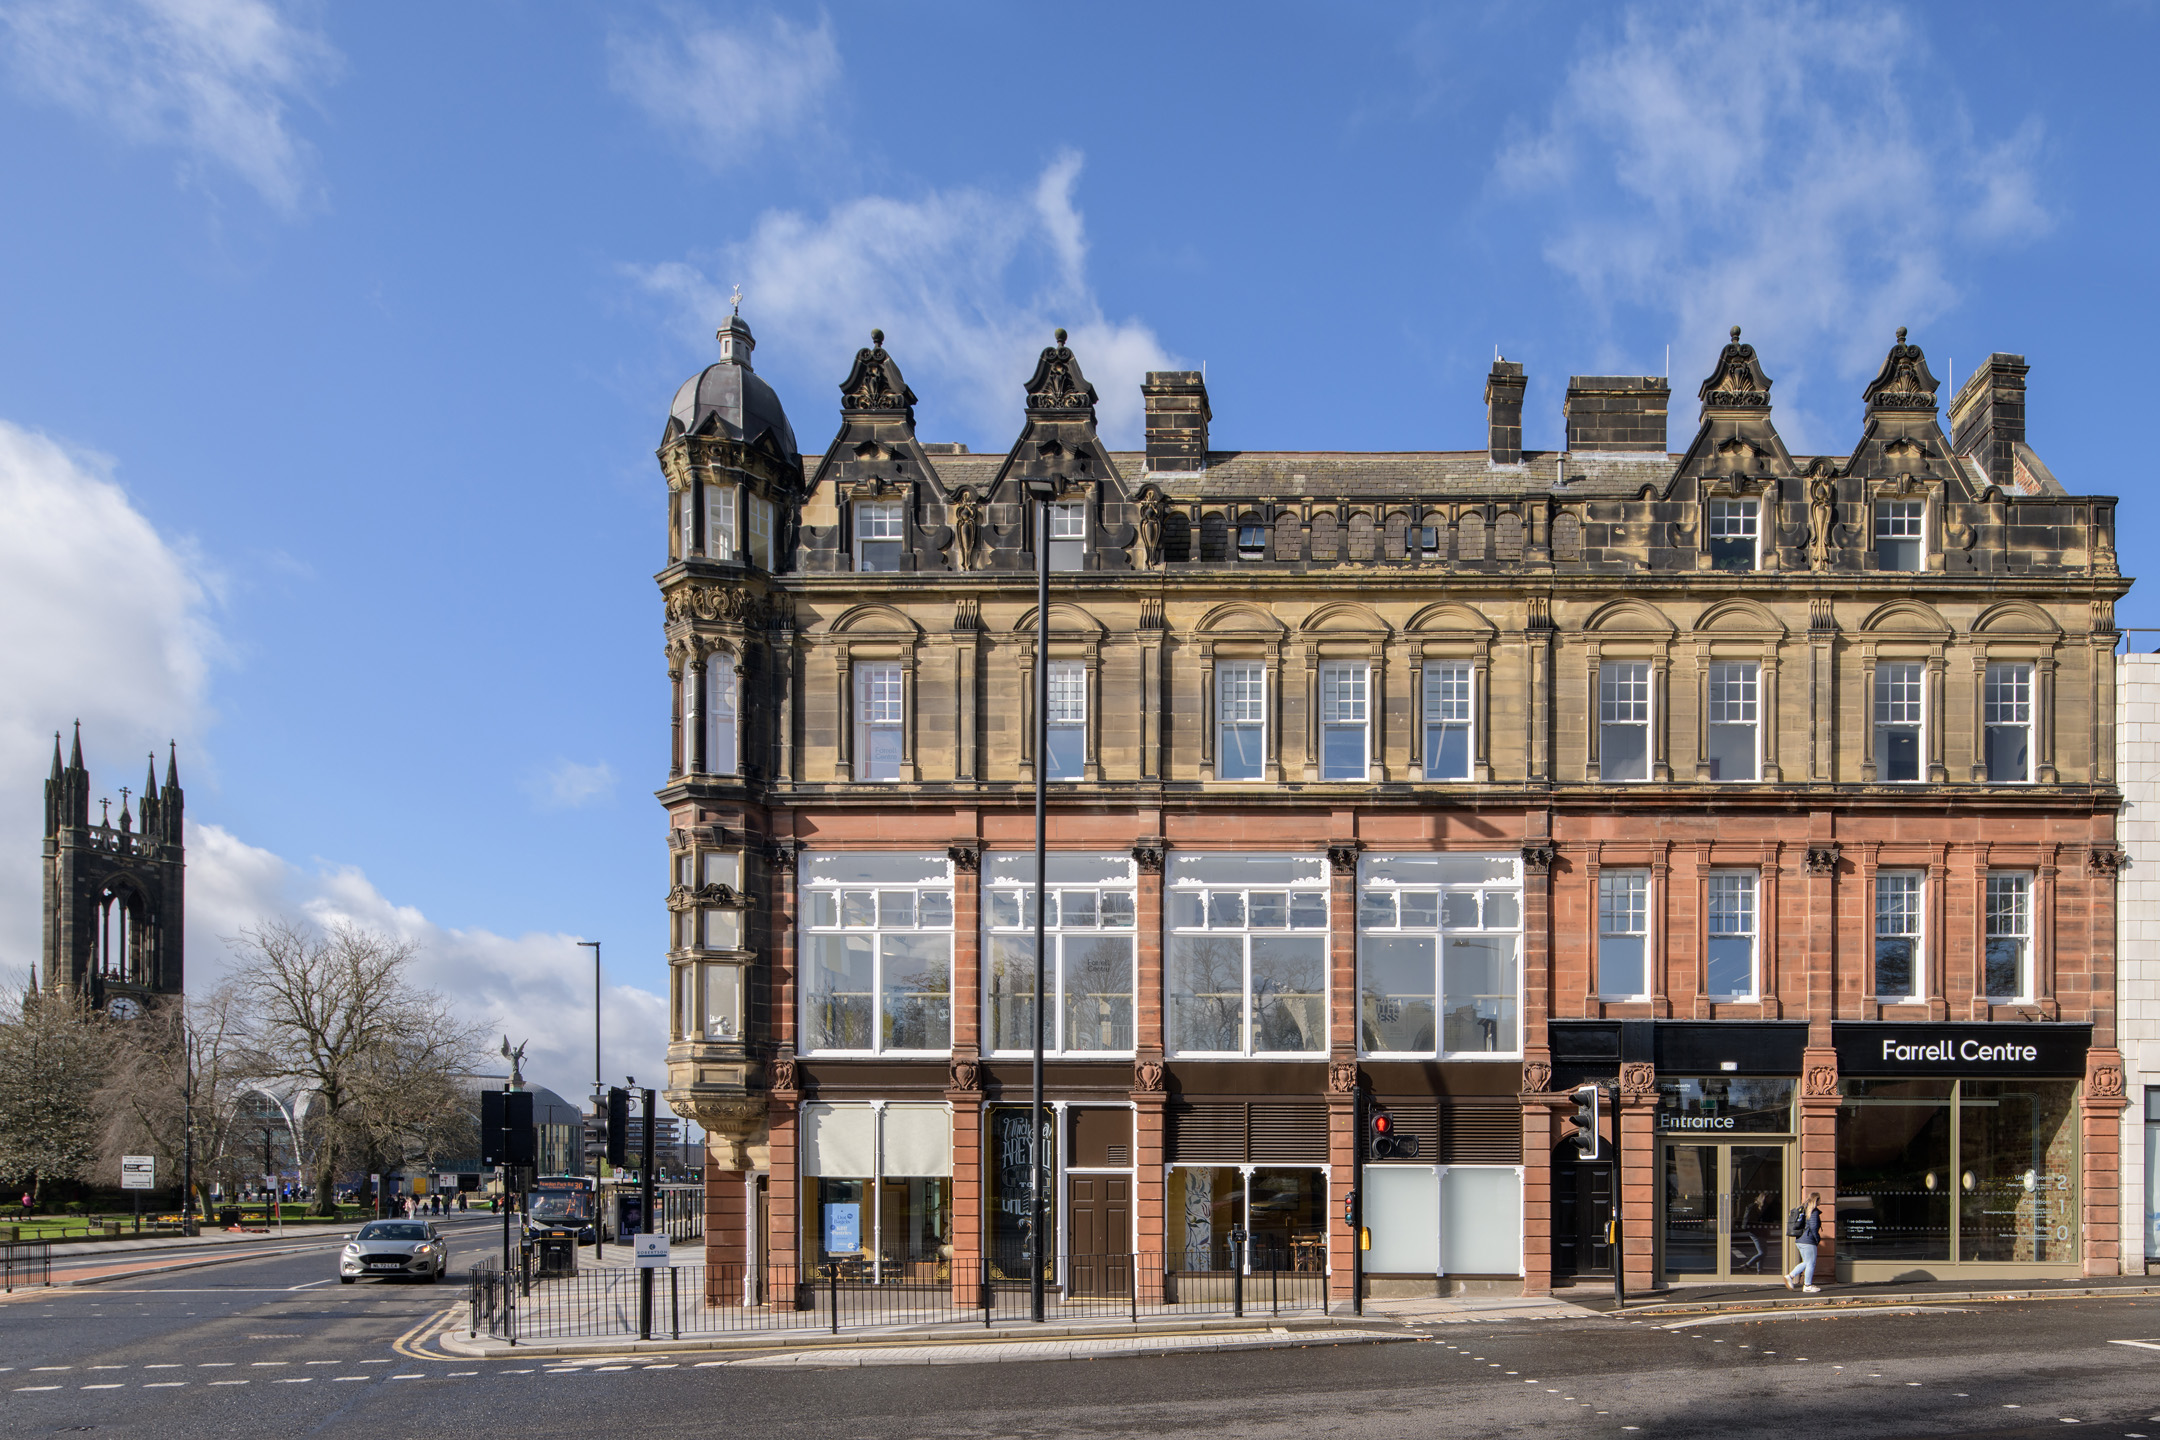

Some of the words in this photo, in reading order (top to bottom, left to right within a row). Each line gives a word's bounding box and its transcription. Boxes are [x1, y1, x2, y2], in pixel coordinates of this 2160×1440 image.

[1882, 1040, 1956, 1061] Farrell
[1960, 1040, 2037, 1061] Centre
[1660, 1113, 1734, 1128] Entrance
[2057, 1175, 2067, 1190] 2
[2059, 1199, 2064, 1214] 1
[2057, 1225, 2068, 1240] 0
